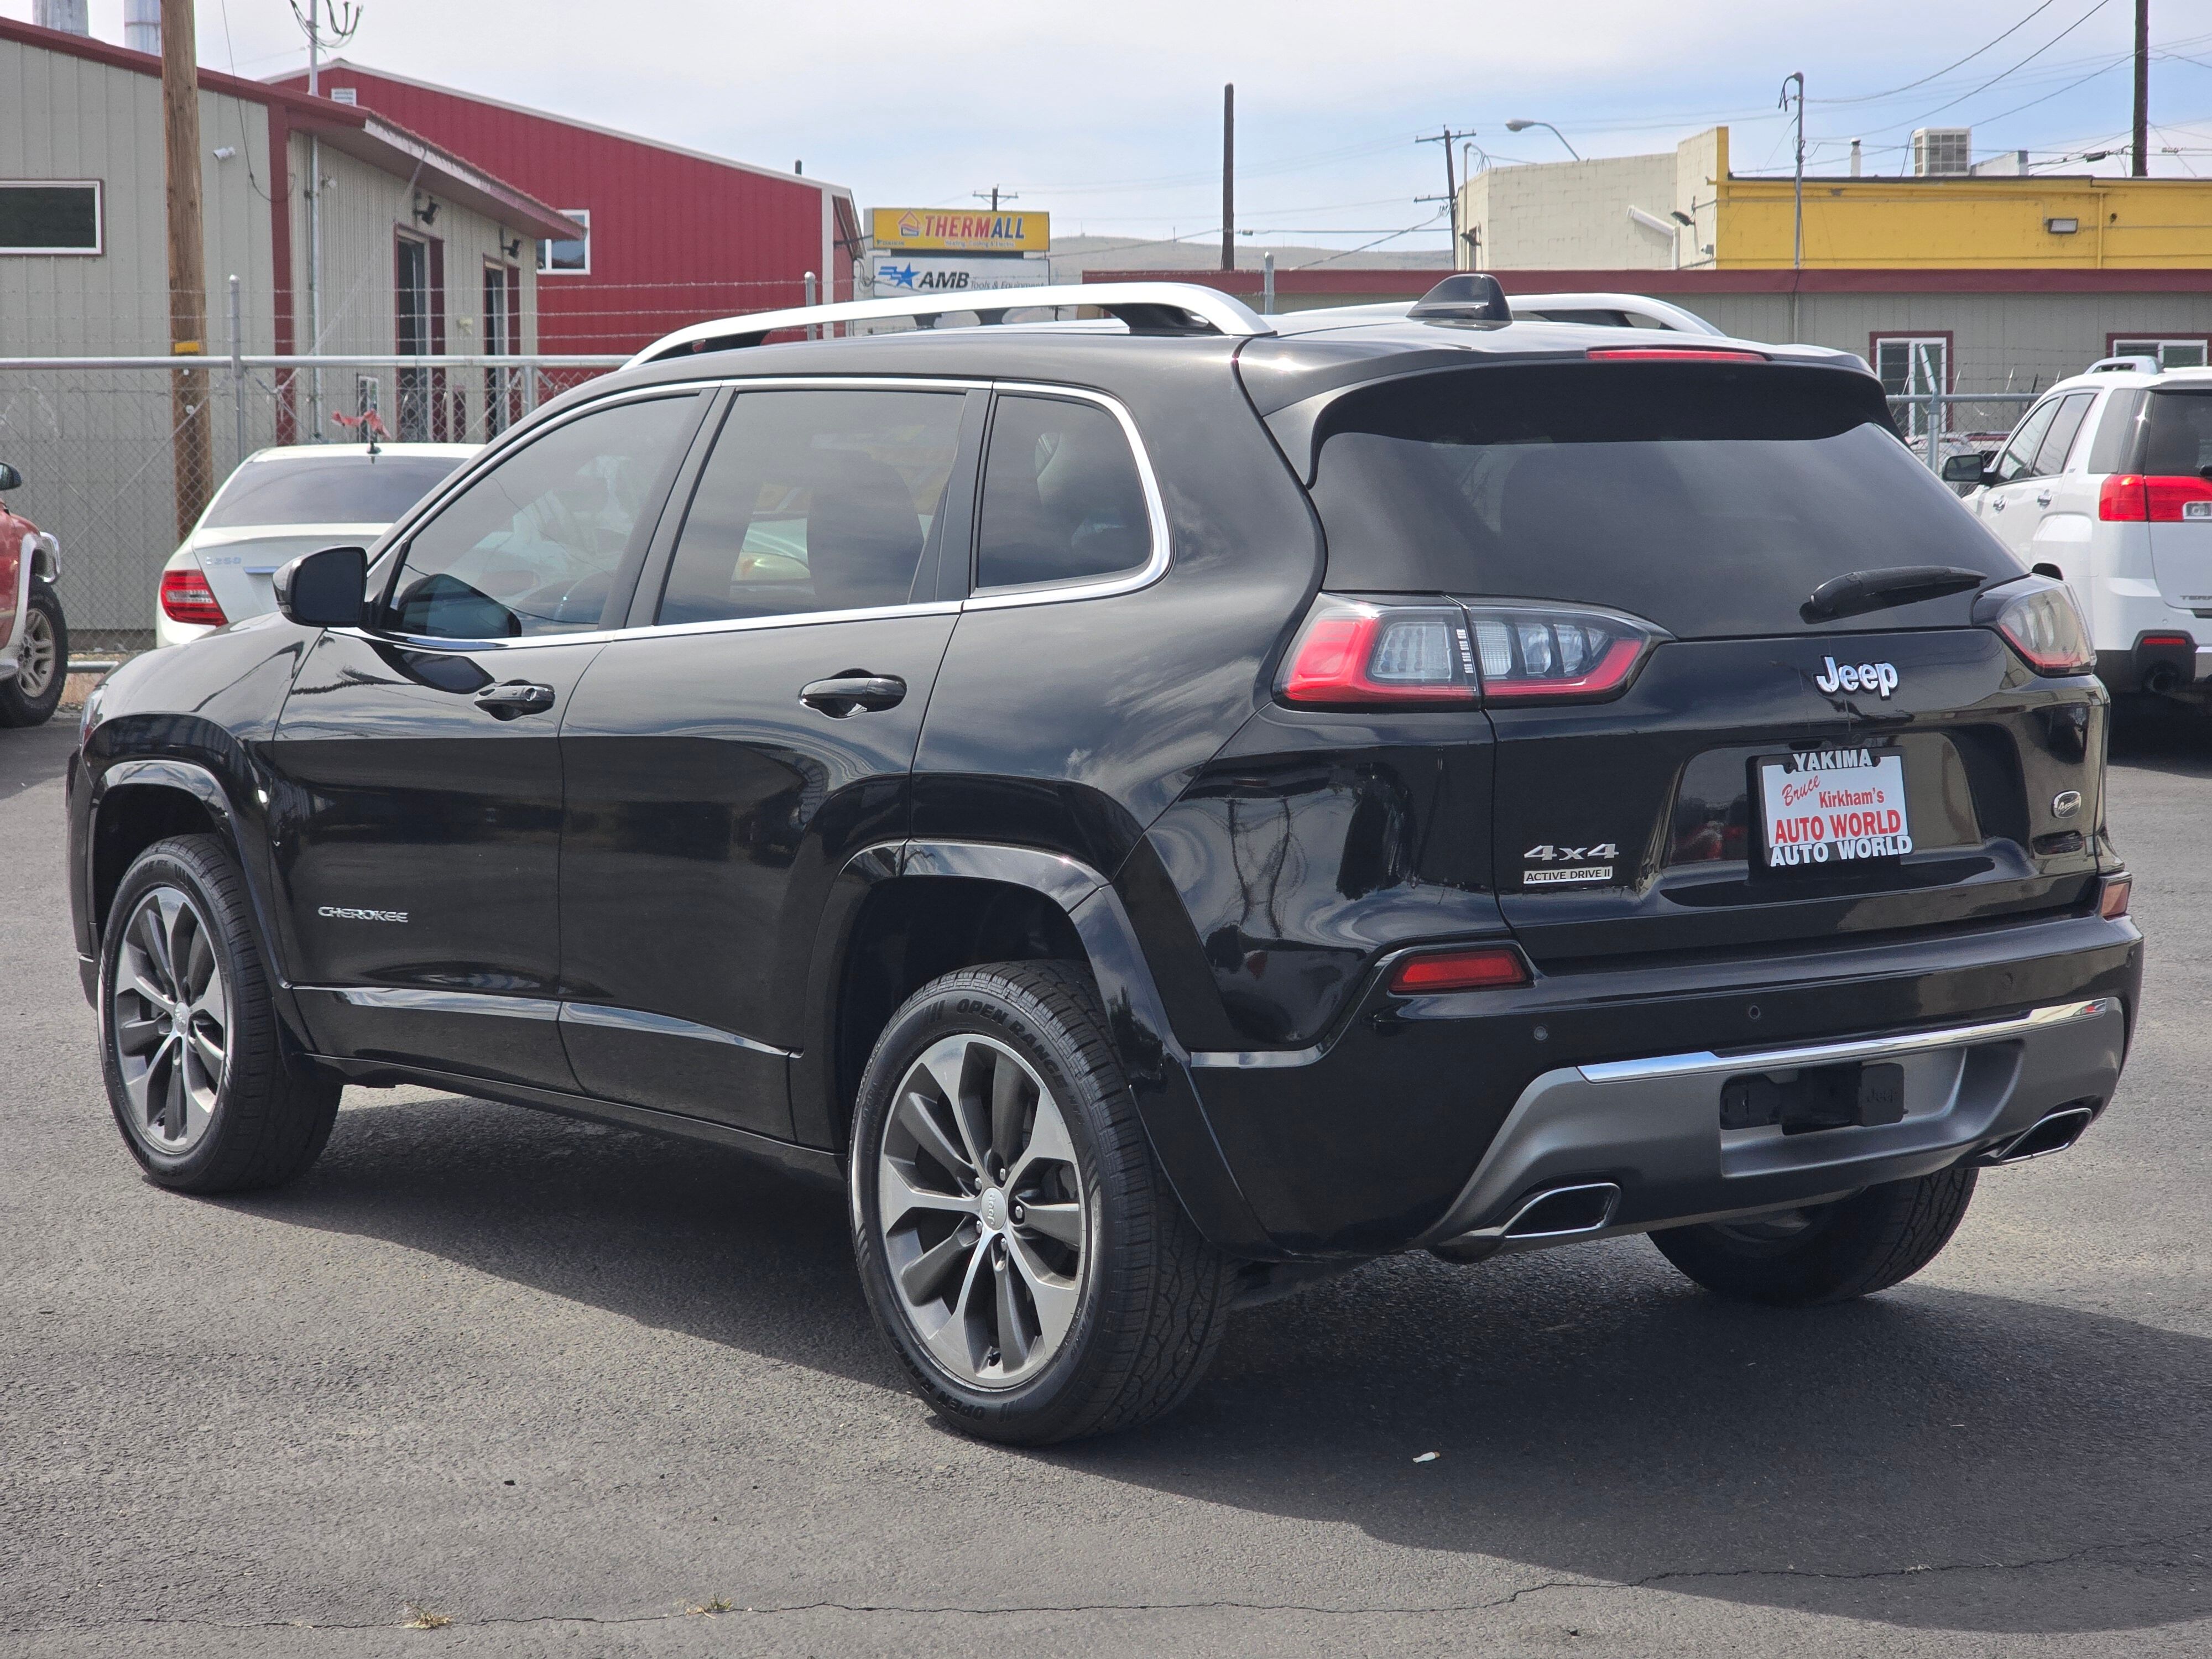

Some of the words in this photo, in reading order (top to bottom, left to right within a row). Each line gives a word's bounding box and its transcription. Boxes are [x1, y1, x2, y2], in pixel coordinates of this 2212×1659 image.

[925, 215, 1025, 239] THERMALL
[919, 271, 969, 289] AMB
[971, 281, 990, 290] Tools
[1816, 656, 1898, 697] Jeep
[1793, 748, 1872, 771] YAKIMA
[1782, 775, 1820, 806] Bruce
[1819, 787, 1885, 808] Kirkham's
[1775, 816, 1824, 844] AUTO
[1829, 810, 1901, 839] WORLD
[1524, 843, 1619, 861] 4x4
[1771, 842, 1829, 867] AUTO
[1837, 835, 1912, 860] WORLD
[1526, 872, 1566, 881] ACTIVE
[1570, 869, 1601, 879] DRIVE
[318, 906, 409, 923] CHEROKEE
[956, 998, 1009, 1026] OPEN
[1008, 1020, 1070, 1088] RANGE
